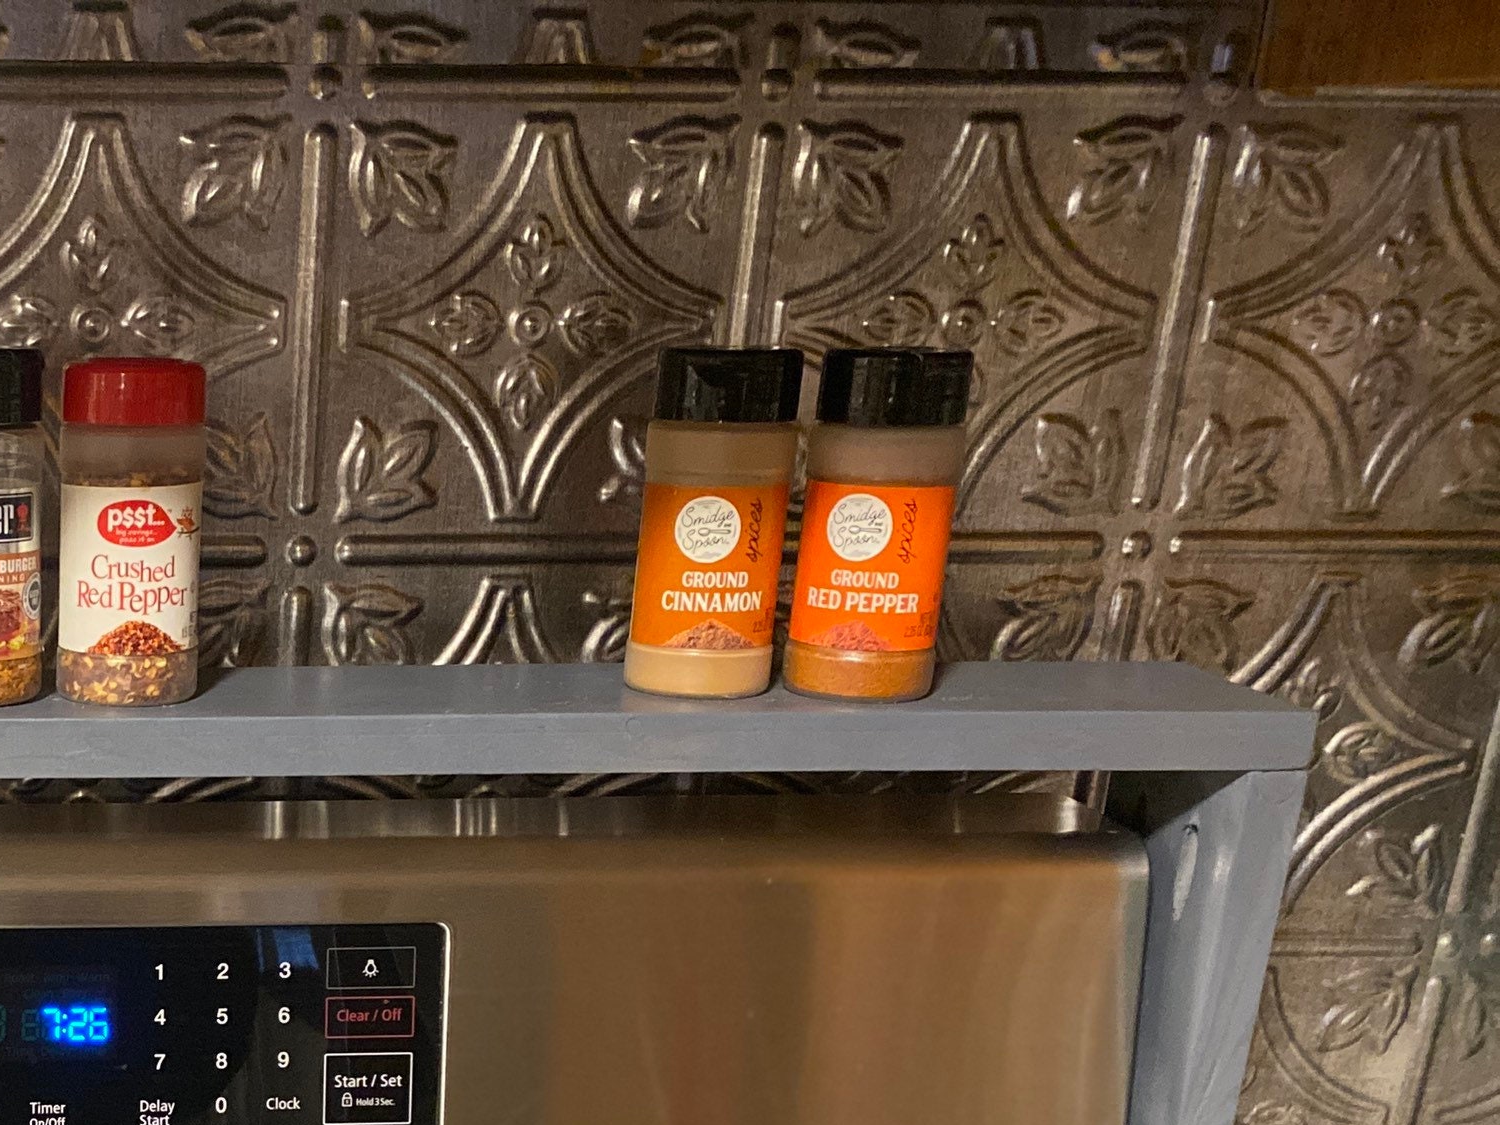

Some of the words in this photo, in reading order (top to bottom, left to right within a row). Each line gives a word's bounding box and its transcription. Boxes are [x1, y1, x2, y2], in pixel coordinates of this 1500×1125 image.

[682, 506, 735, 528] Smidge
[834, 503, 887, 526] Smidge
[746, 498, 763, 562] spices
[897, 499, 918, 563] spices
[683, 529, 724, 554] Spoon
[833, 526, 874, 552] Spoon
[91, 554, 176, 582] Crushed
[682, 571, 749, 588] GROUND
[831, 568, 900, 589] GROUND
[77, 582, 112, 608] Red
[118, 582, 188, 615] Pepper
[661, 590, 763, 613] CINNAMON
[807, 586, 841, 610] RED
[844, 592, 919, 613] PEPPER
[155, 965, 165, 981] 1
[217, 963, 229, 979] 2
[279, 962, 291, 979] 3
[154, 1009, 166, 1026] 4
[217, 1009, 228, 1025] 5
[278, 1008, 290, 1025] 6
[337, 1009, 370, 1023] Clear
[381, 1008, 402, 1022] Off
[42, 1007, 110, 1042] 7:26
[154, 1054, 166, 1070] 7
[216, 1053, 228, 1069] 8
[277, 1052, 289, 1068] 9
[334, 1074, 367, 1088] Start
[380, 1074, 402, 1087] Set
[30, 1101, 66, 1115] Timer
[139, 1100, 175, 1116] Delay
[215, 1097, 227, 1113] 0
[266, 1097, 300, 1111] Clock
[355, 1098, 374, 1106] Hold
[374, 1098, 380, 1106] 3
